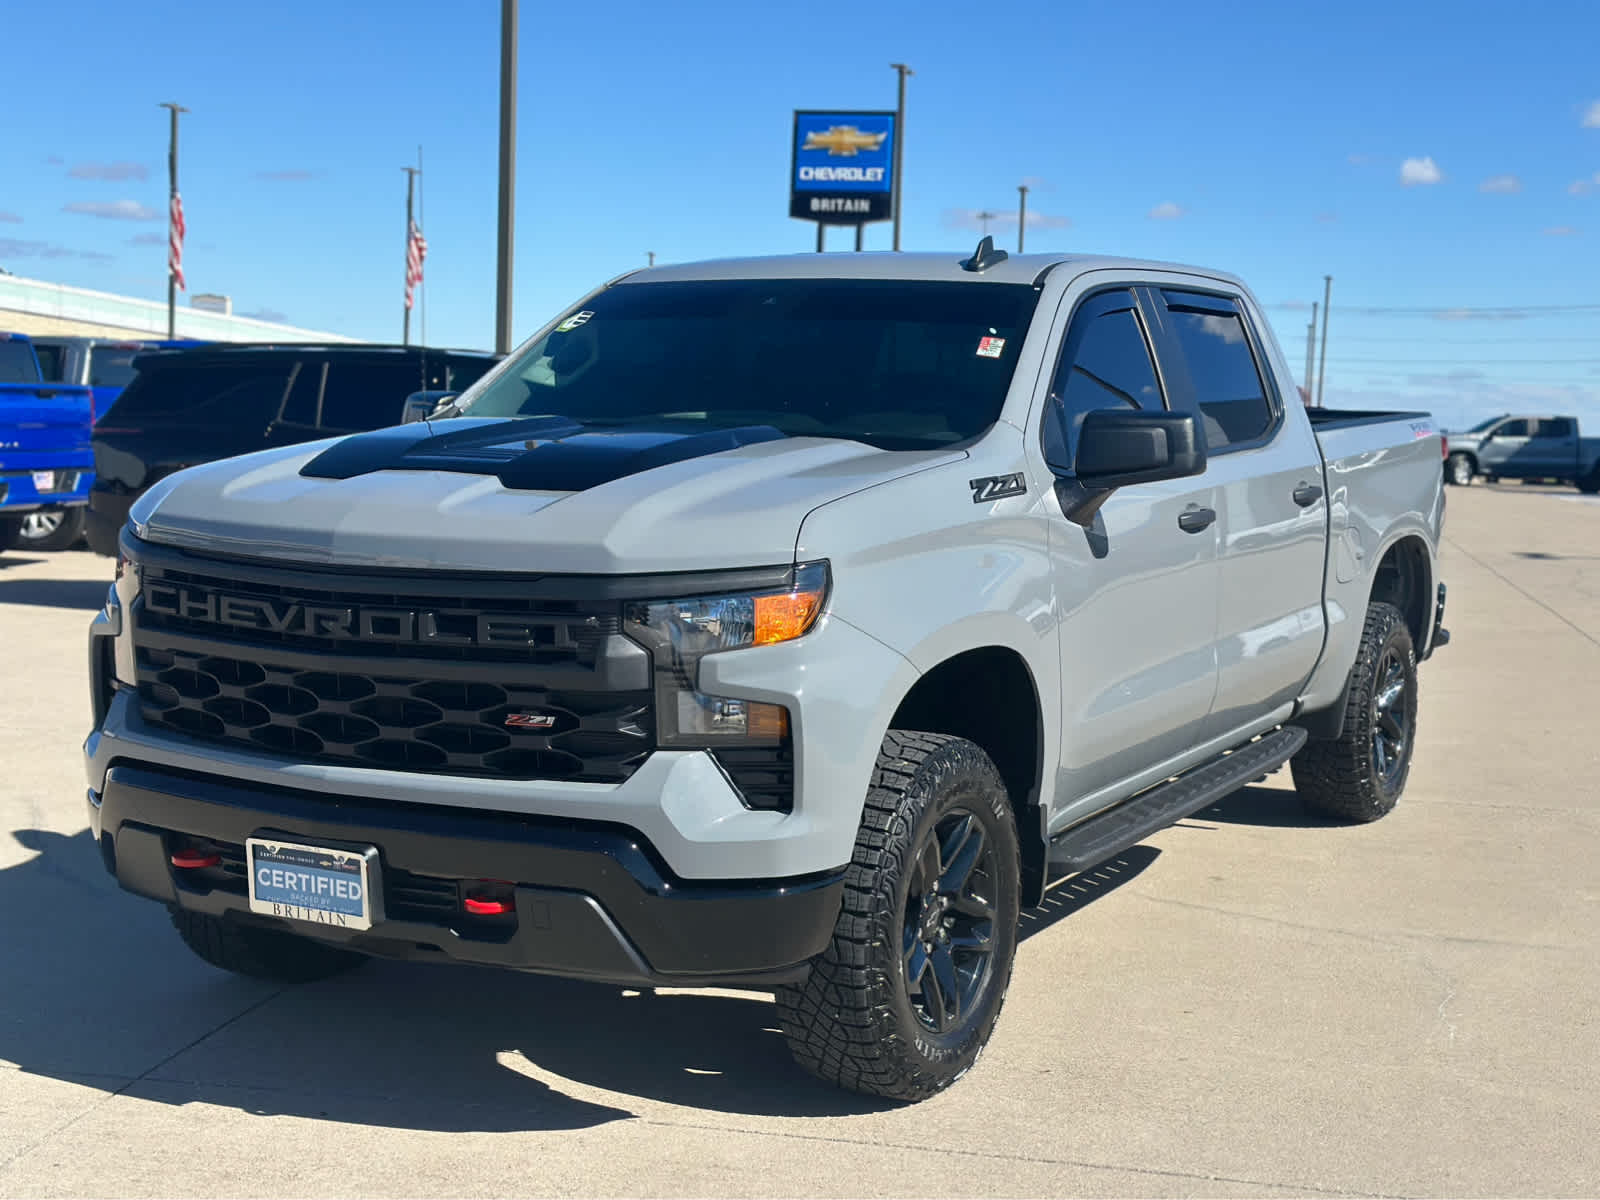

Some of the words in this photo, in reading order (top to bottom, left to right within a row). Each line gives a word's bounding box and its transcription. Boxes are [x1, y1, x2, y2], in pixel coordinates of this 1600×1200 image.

[799, 166, 885, 182] CHEVROLET
[810, 197, 871, 213] BRITAIN
[969, 471, 1028, 504] Z71
[142, 583, 592, 650] CHEVROLET
[504, 713, 556, 728] Z71
[257, 868, 362, 900] CERTIFIED
[273, 903, 346, 926] BRITAIN
